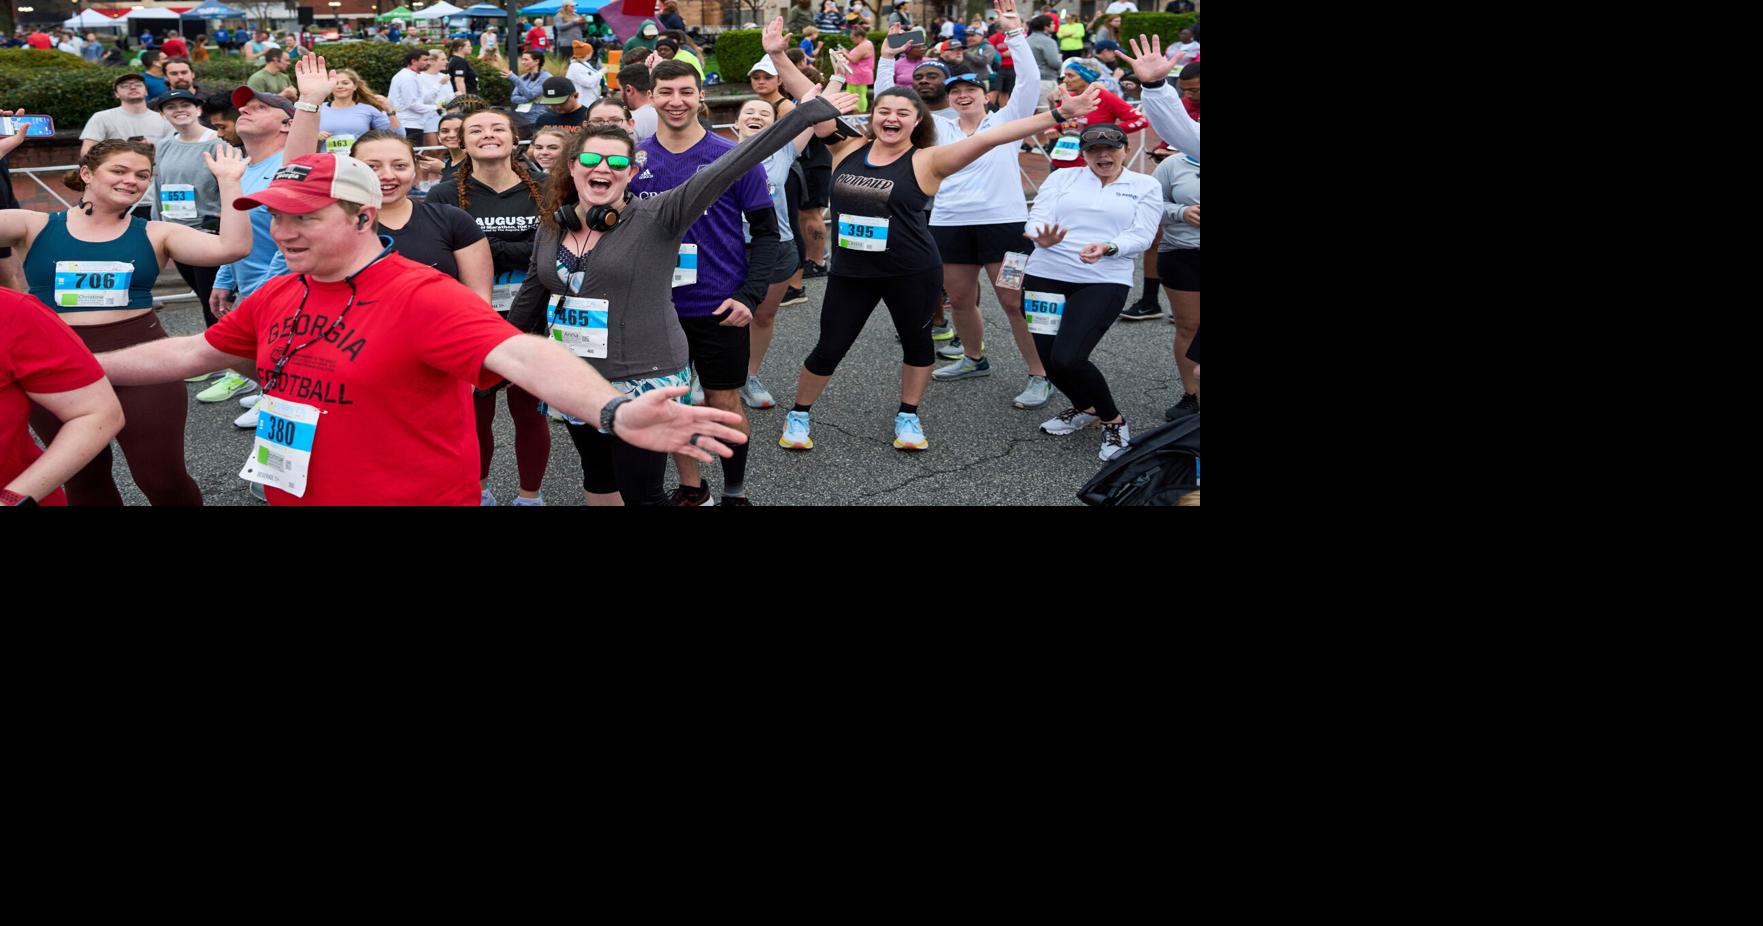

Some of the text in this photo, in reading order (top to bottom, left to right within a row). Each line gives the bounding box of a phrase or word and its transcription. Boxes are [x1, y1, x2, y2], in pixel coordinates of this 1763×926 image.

[836, 173, 895, 190] MOTIVATED
[847, 223, 875, 238] 395
[75, 272, 116, 289] 706
[1031, 300, 1058, 314] 560
[558, 308, 589, 327] 465
[267, 313, 367, 362] GEORGIA
[257, 367, 354, 405] FOOTBALL
[267, 415, 296, 447] 380
